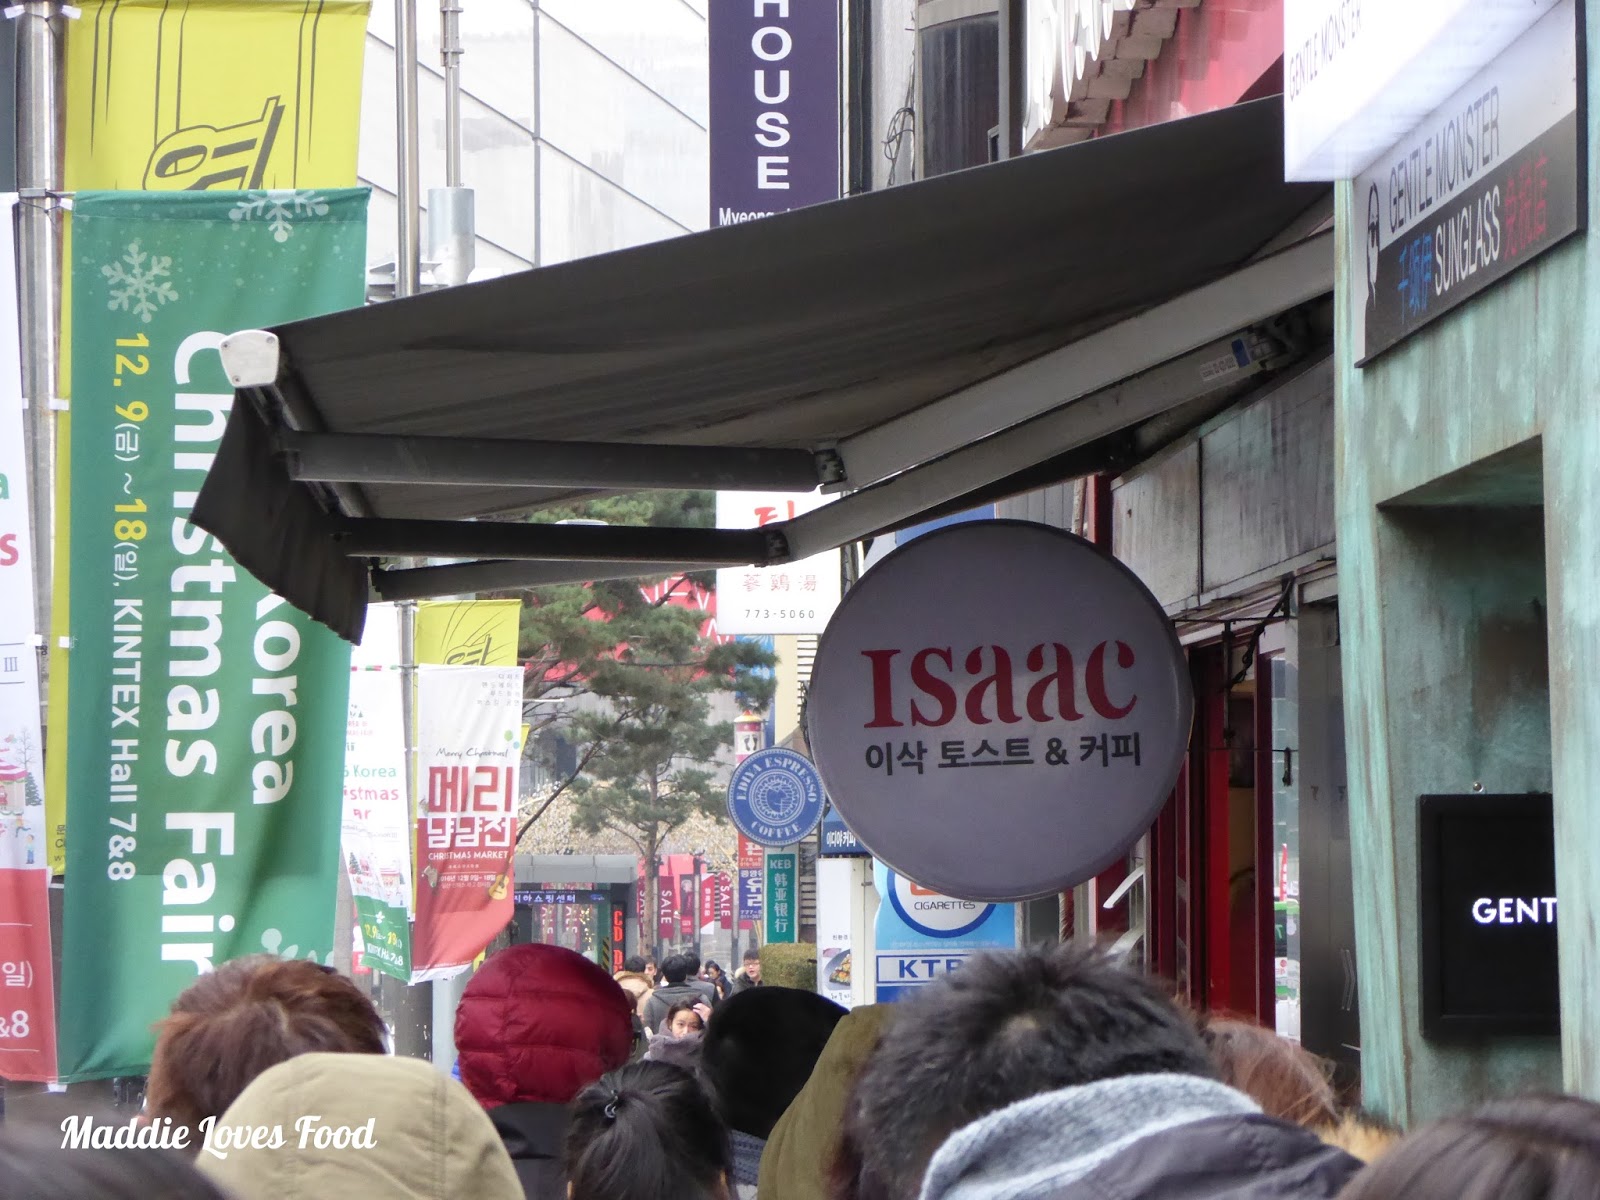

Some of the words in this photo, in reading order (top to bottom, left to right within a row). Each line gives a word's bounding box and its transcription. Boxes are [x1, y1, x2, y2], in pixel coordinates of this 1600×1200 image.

[1289, 32, 1318, 102] GENTLE
[1390, 138, 1433, 234] GENTLE
[1436, 85, 1499, 201] MONSTER
[1435, 184, 1500, 296] SUNGLASS
[113, 332, 149, 387] 12.
[745, 609, 815, 619] 773-5060
[111, 599, 143, 729] KINTEX
[109, 739, 138, 803] Hall
[353, 764, 397, 778] Korea
[436, 747, 462, 760] Merry
[865, 740, 928, 776] 이삭
[937, 738, 1034, 768] 토스트
[1045, 737, 1070, 766] &
[1079, 731, 1141, 768] 커피
[429, 766, 514, 813] 메리
[736, 763, 762, 801] EDIYA
[765, 756, 818, 803] ESPRESSO
[107, 813, 137, 881] 7&8
[427, 816, 511, 849] 냠냠전
[751, 820, 802, 839] COFFEE
[428, 851, 472, 860] CHRISTMAS
[473, 850, 509, 859] MARKET
[769, 859, 792, 869] KEB
[660, 890, 673, 924] SALE
[720, 885, 731, 916] SALE
[773, 873, 788, 933] 韩亚银行
[914, 900, 976, 911] CIGARETTES
[1472, 897, 1558, 923] GENT
